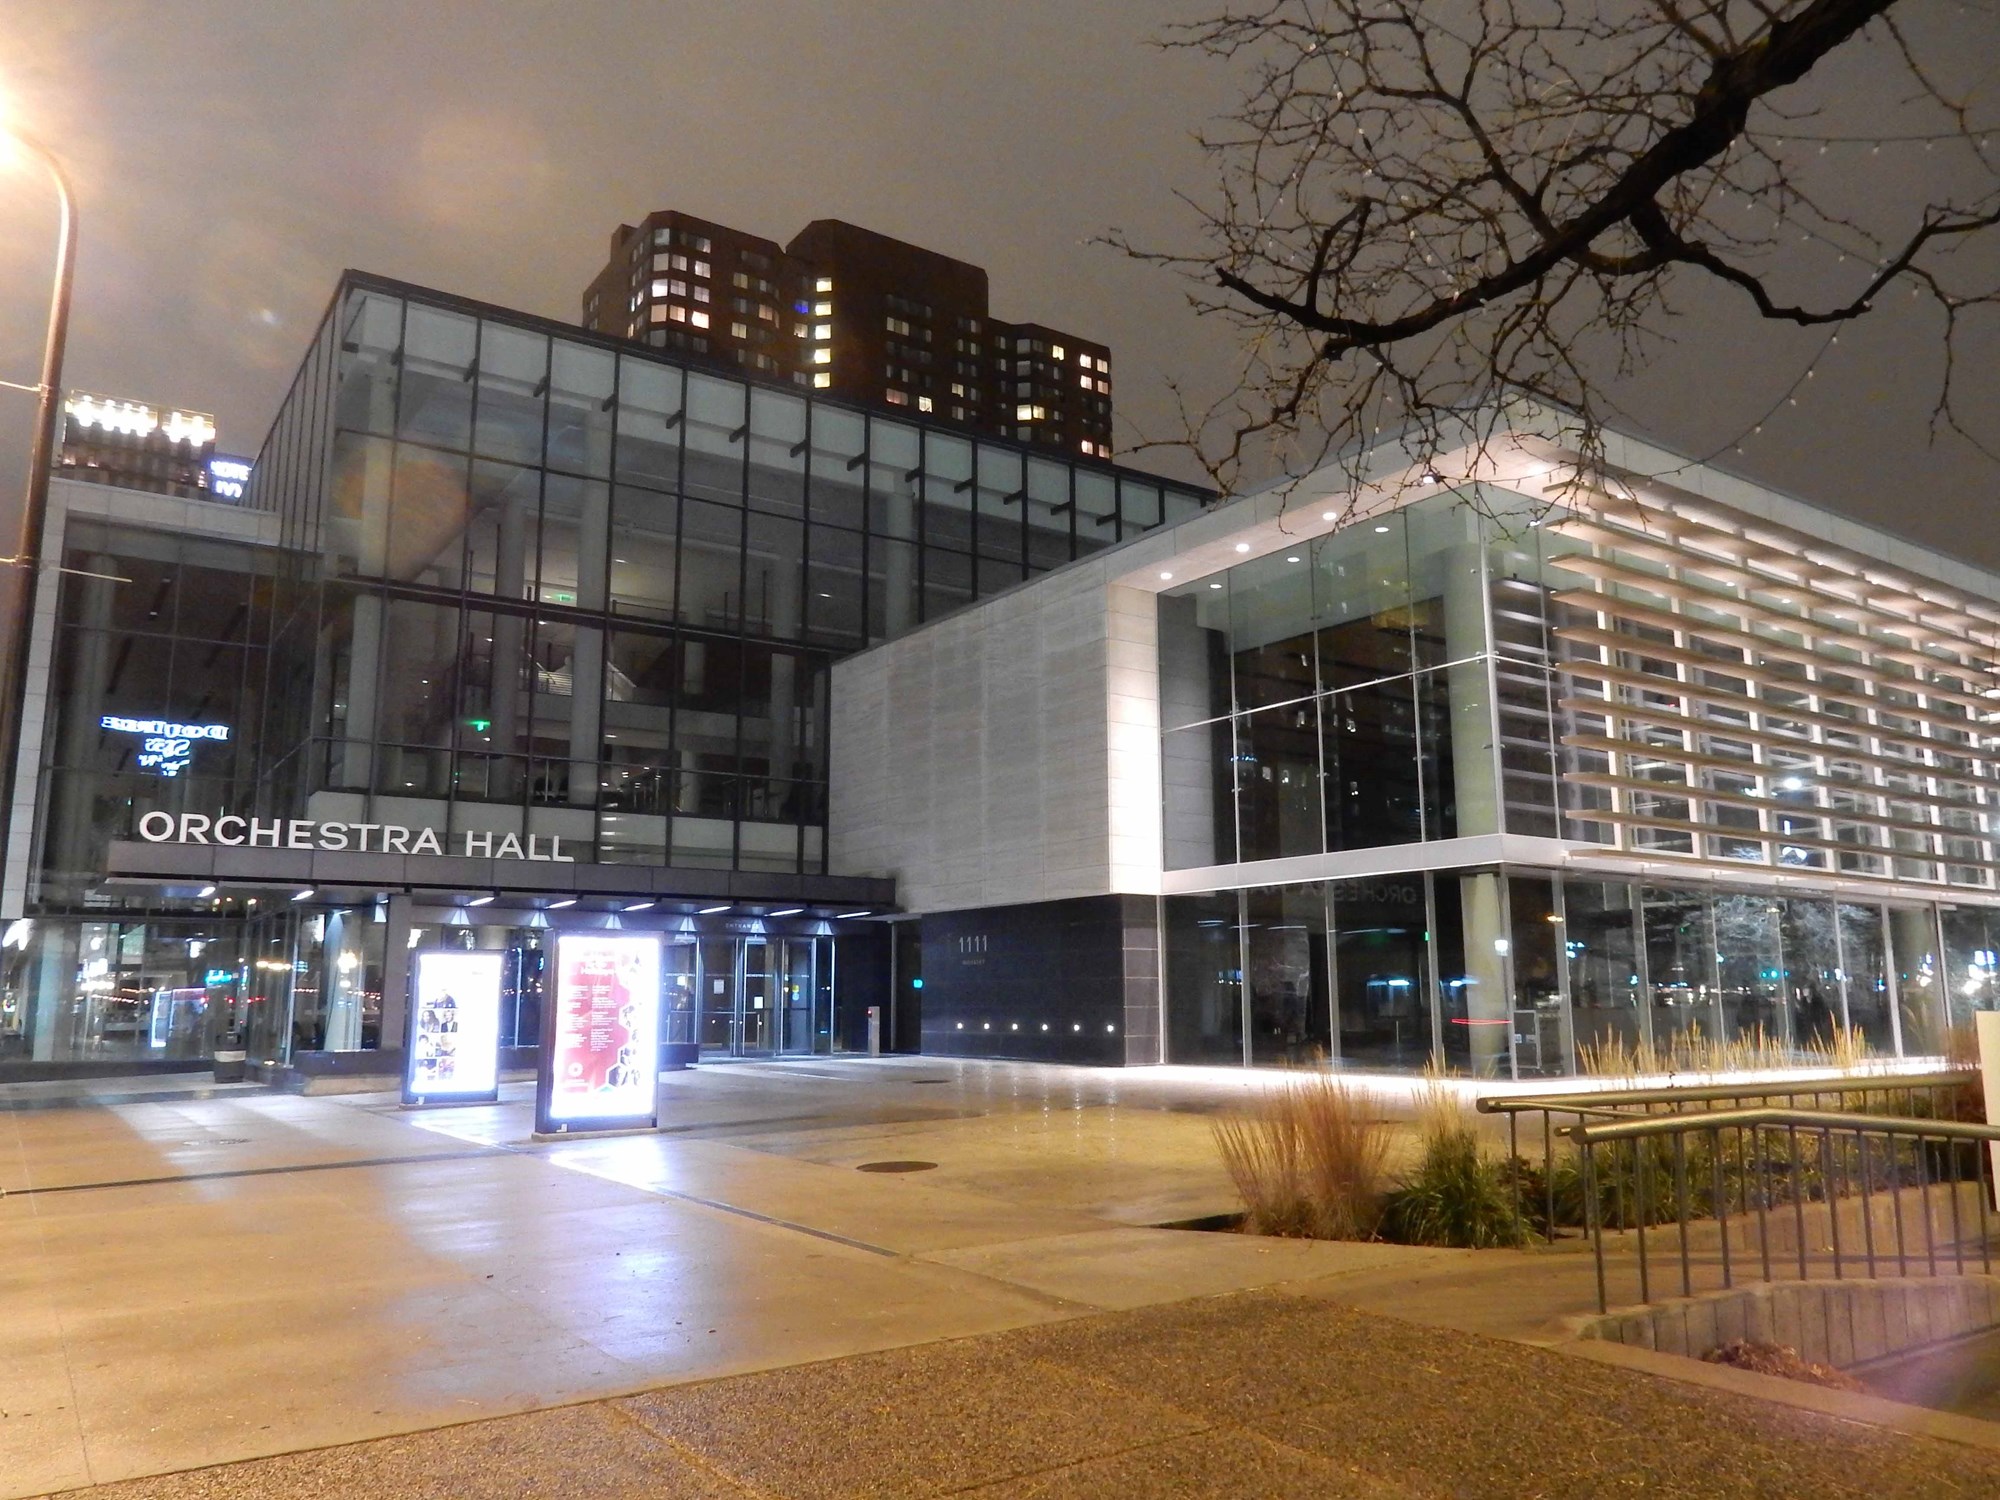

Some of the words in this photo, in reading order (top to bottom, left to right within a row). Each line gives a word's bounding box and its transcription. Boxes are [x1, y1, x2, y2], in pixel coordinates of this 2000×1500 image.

[139, 811, 443, 856] ORCHESTRA
[465, 830, 575, 862] HALL
[958, 934, 988, 953] 1111
